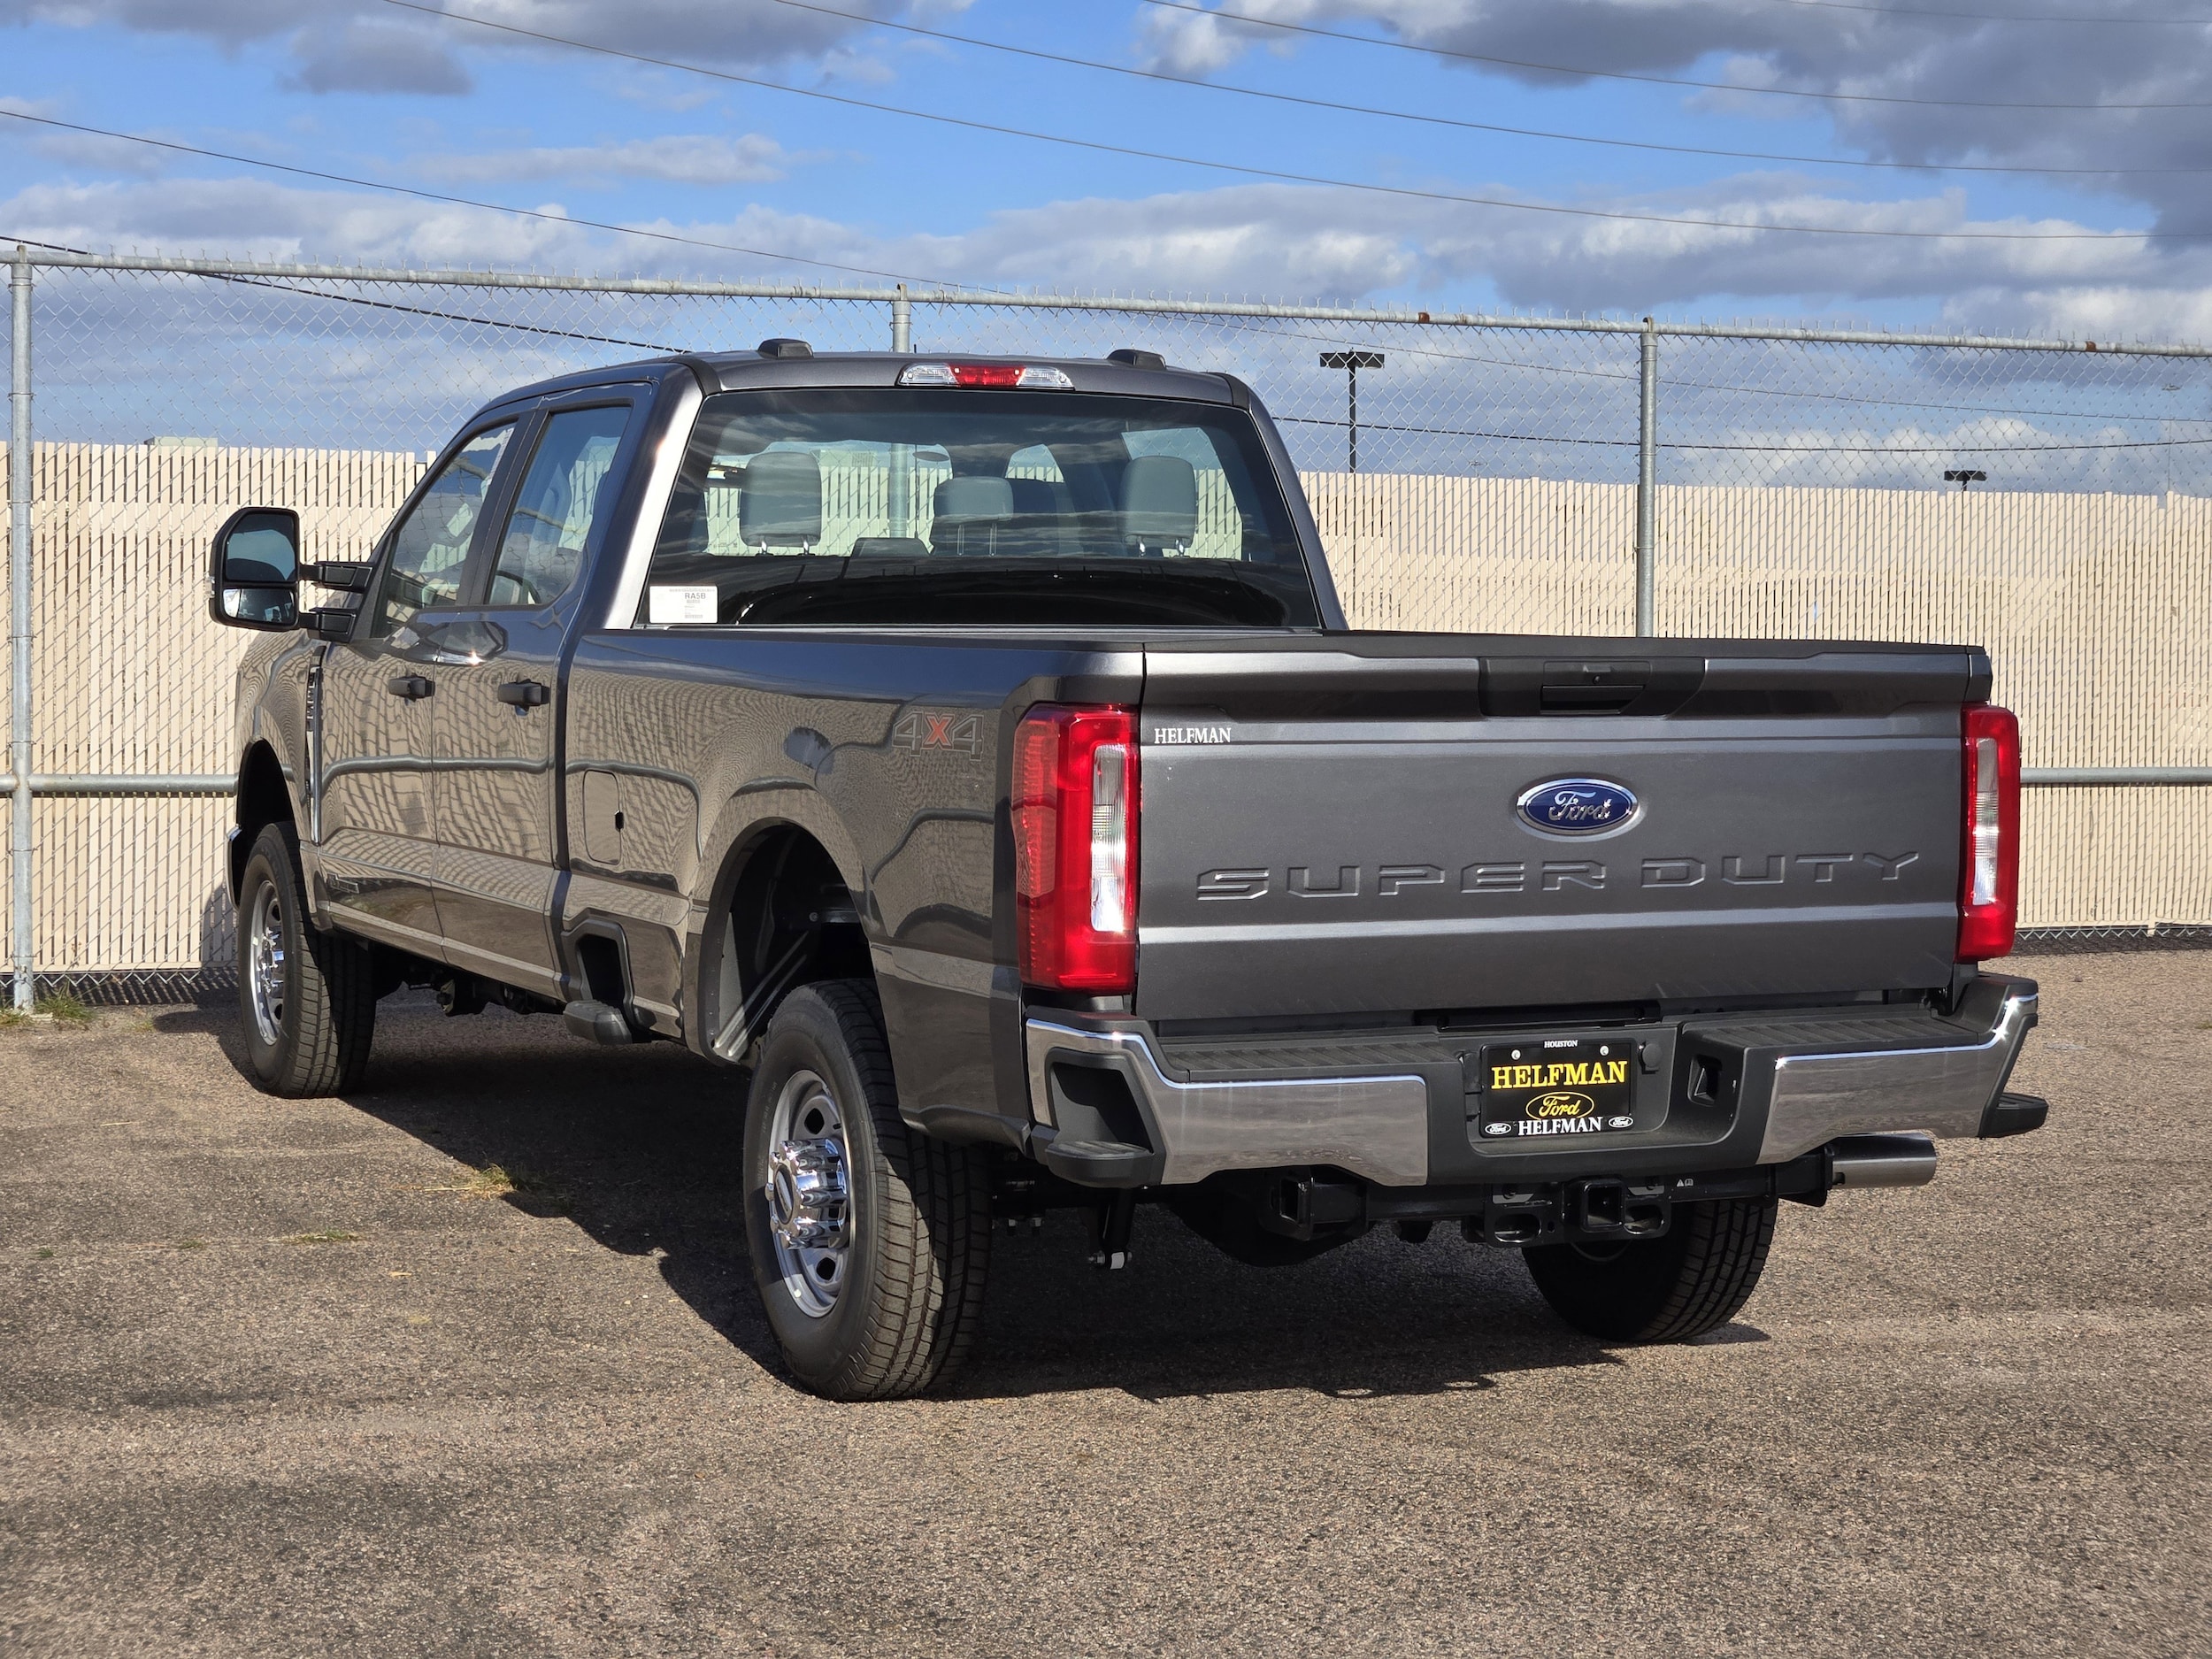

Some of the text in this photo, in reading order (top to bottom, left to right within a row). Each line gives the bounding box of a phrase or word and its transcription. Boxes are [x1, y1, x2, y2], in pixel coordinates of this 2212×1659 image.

[1154, 727, 1232, 744] HELFMAN
[1548, 790, 1613, 821] Ford
[1196, 850, 1919, 901] SUPER DUTY
[1544, 1040, 1578, 1048] HOUSTON
[1491, 1060, 1628, 1090] HELFMAN
[1538, 1094, 1581, 1117] Ford
[1517, 1116, 1604, 1136] HELFMAN
